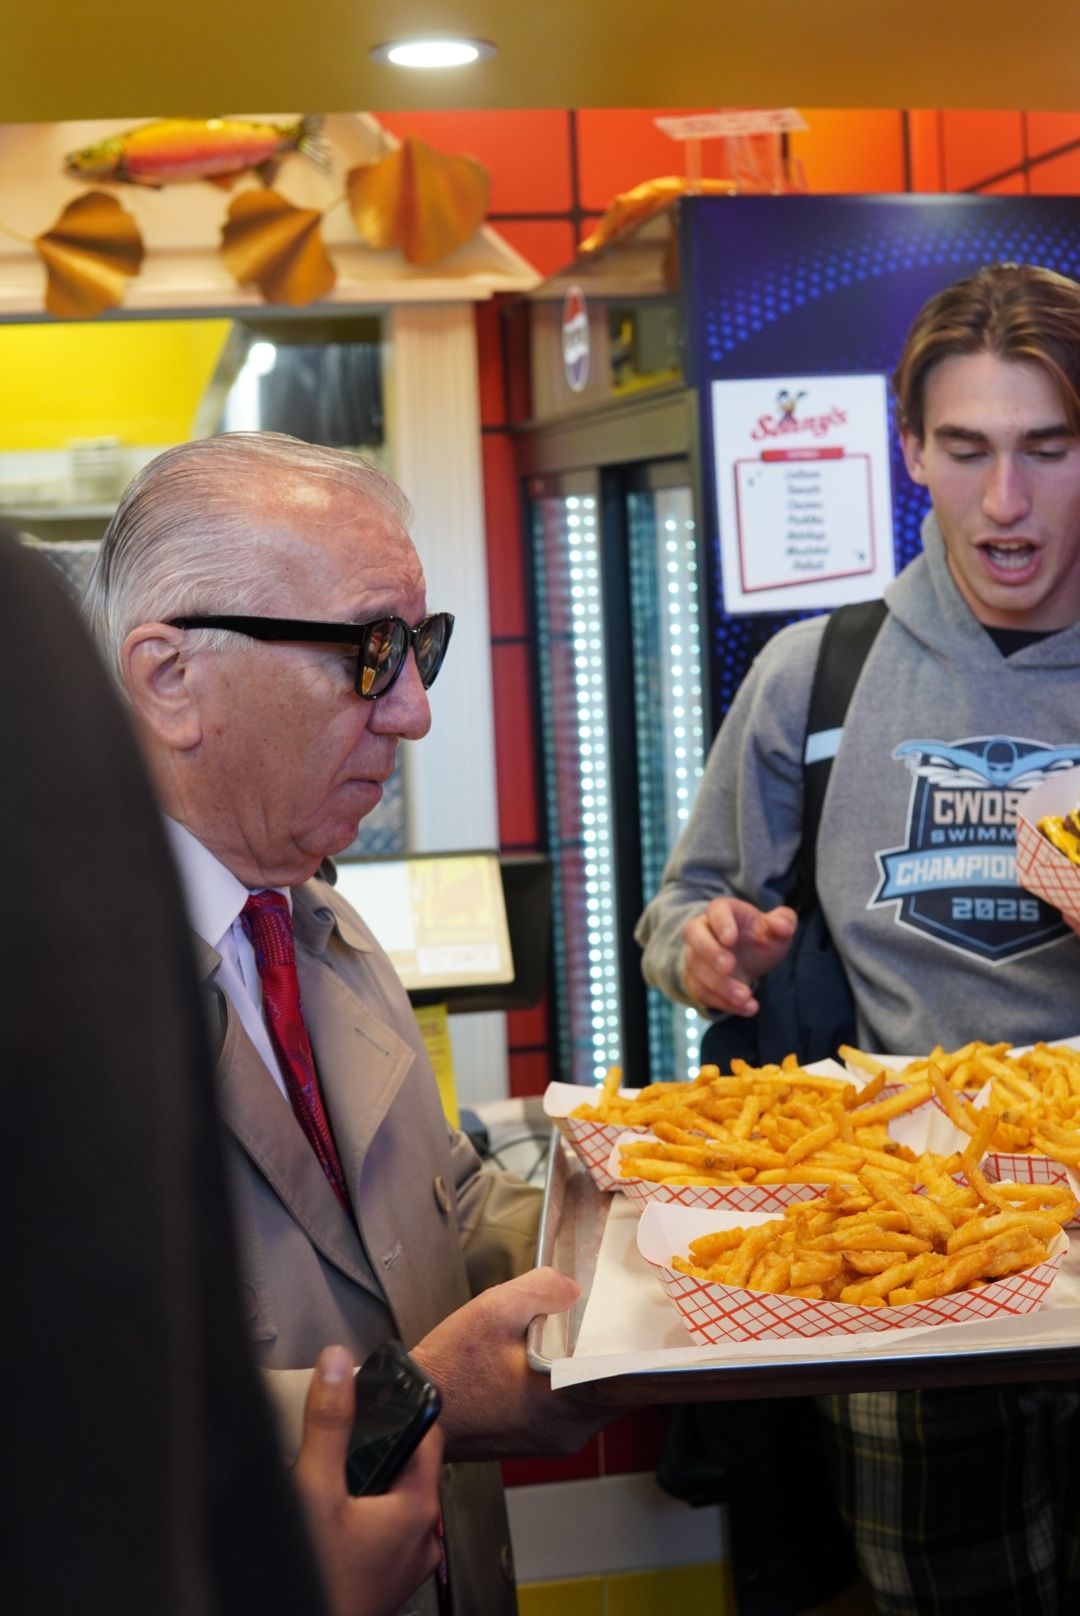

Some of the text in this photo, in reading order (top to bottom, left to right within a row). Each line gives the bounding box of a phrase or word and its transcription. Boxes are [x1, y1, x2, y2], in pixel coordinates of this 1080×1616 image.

[933, 790, 1019, 825] CWOS
[931, 828, 1017, 843] SWIMM
[896, 855, 1017, 885] CHAMPION
[952, 898, 1039, 921] 2025
